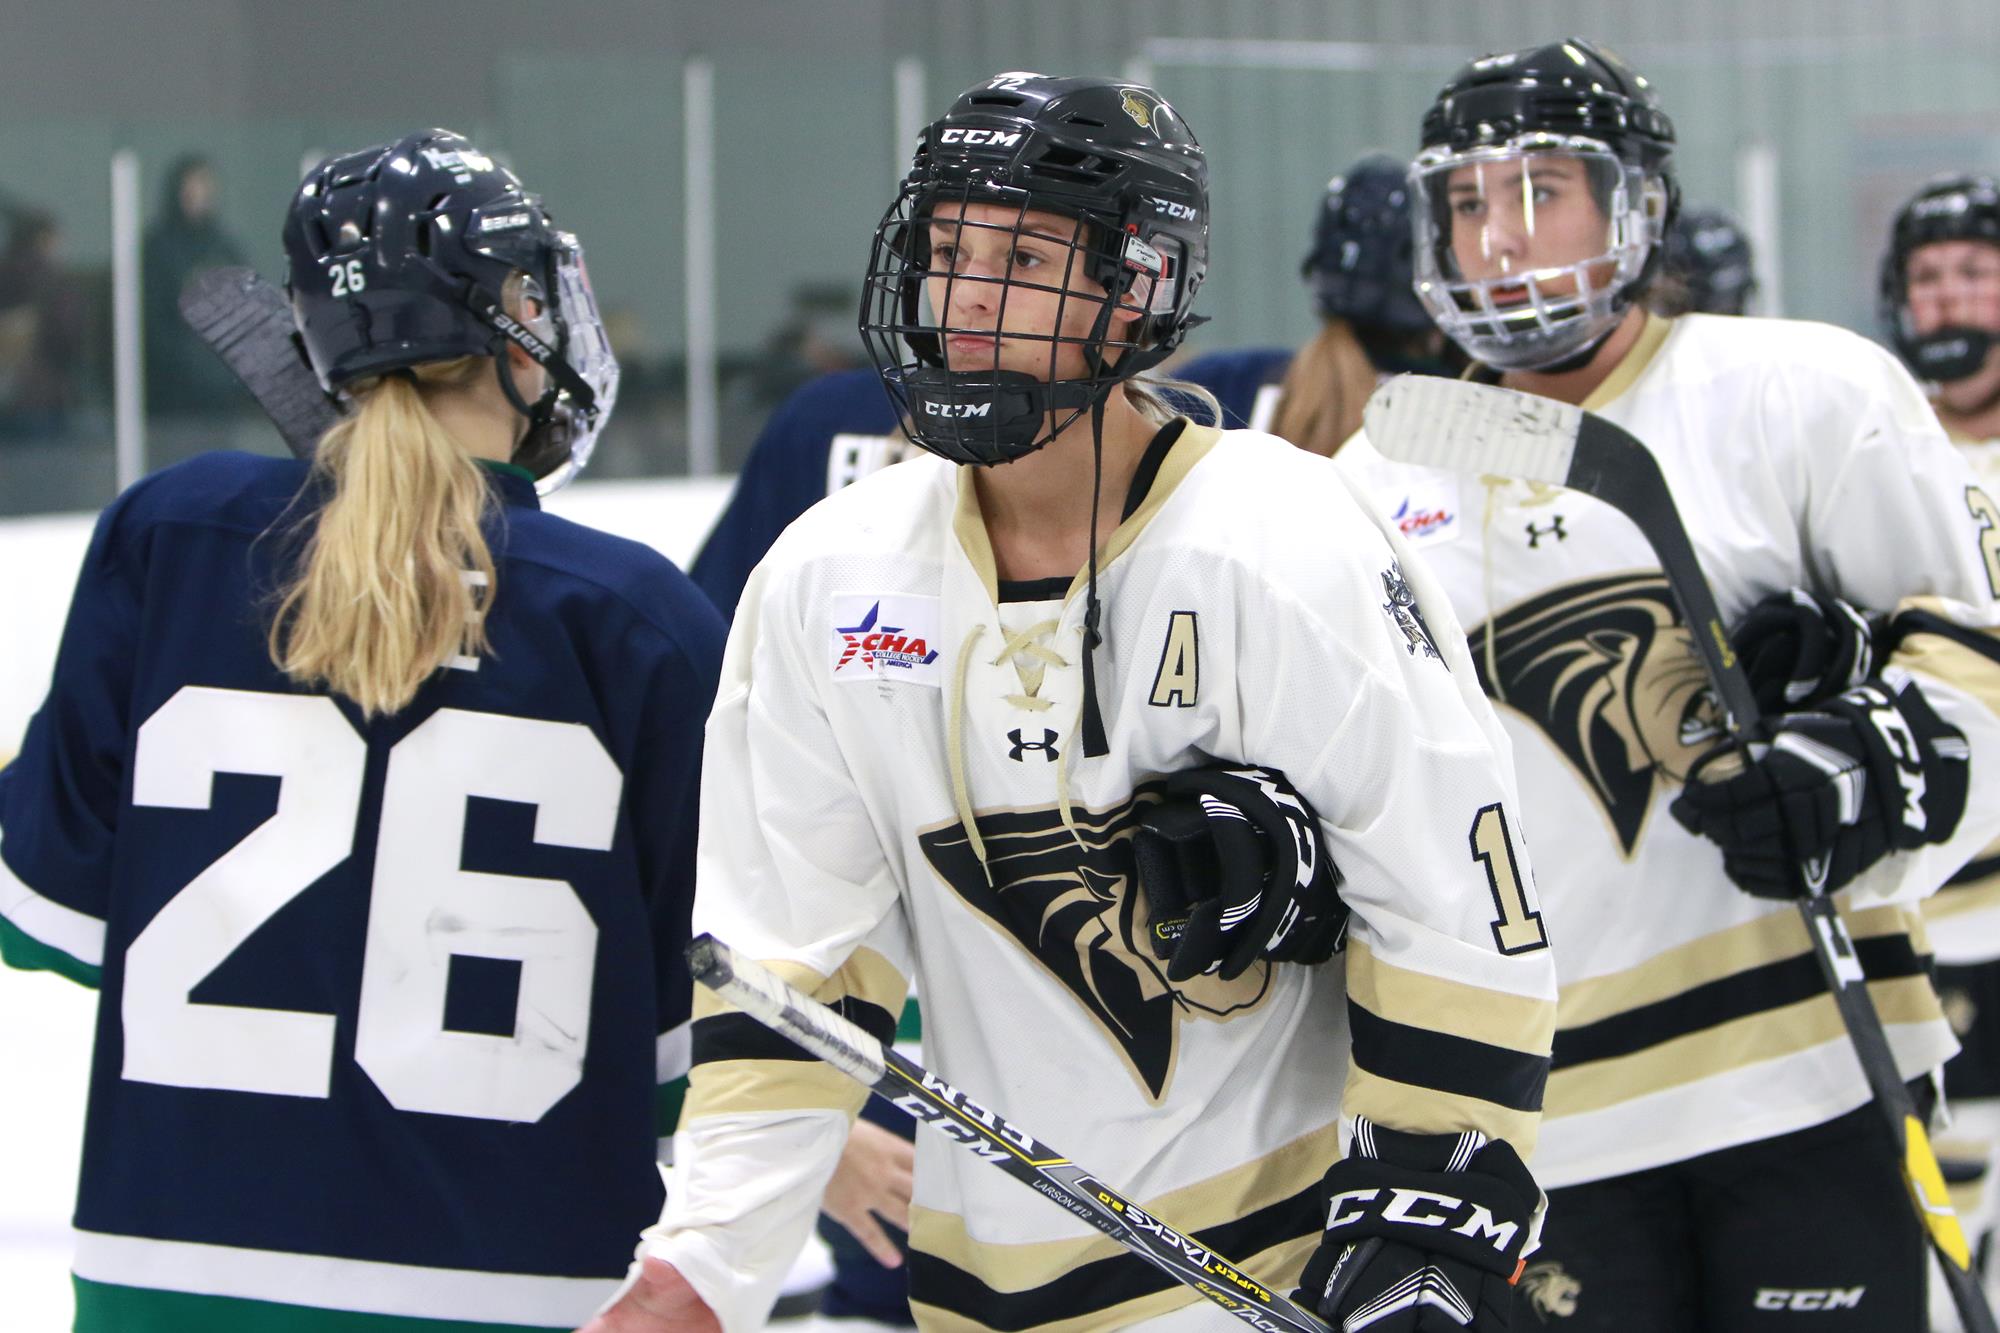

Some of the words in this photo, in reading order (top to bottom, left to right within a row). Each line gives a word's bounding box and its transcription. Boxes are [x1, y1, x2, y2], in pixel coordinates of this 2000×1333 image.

[941, 128, 1022, 147] CCM
[1151, 196, 1197, 221] CCM
[328, 259, 366, 297] 26
[924, 400, 992, 418] CCM
[862, 633, 926, 656] CHA
[874, 651, 902, 661] COLLEGE
[901, 653, 925, 664] HOCKEY
[886, 660, 913, 669] AMERICA
[1148, 610, 1199, 707] A
[1839, 685, 1928, 831] CCM
[1222, 769, 1316, 952] CCM
[121, 685, 624, 1123] 26
[892, 1092, 1012, 1163] CCM
[921, 1071, 1035, 1155] CCM
[1032, 1179, 1075, 1208] LARSON
[1071, 1199, 1093, 1219] #12
[1123, 1204, 1213, 1270] TACKS
[1326, 1187, 1520, 1252] CCM
[1193, 1280, 1238, 1308] SUPER
[1215, 1262, 1272, 1303] SUPER
[1754, 1285, 1866, 1311] CCM
